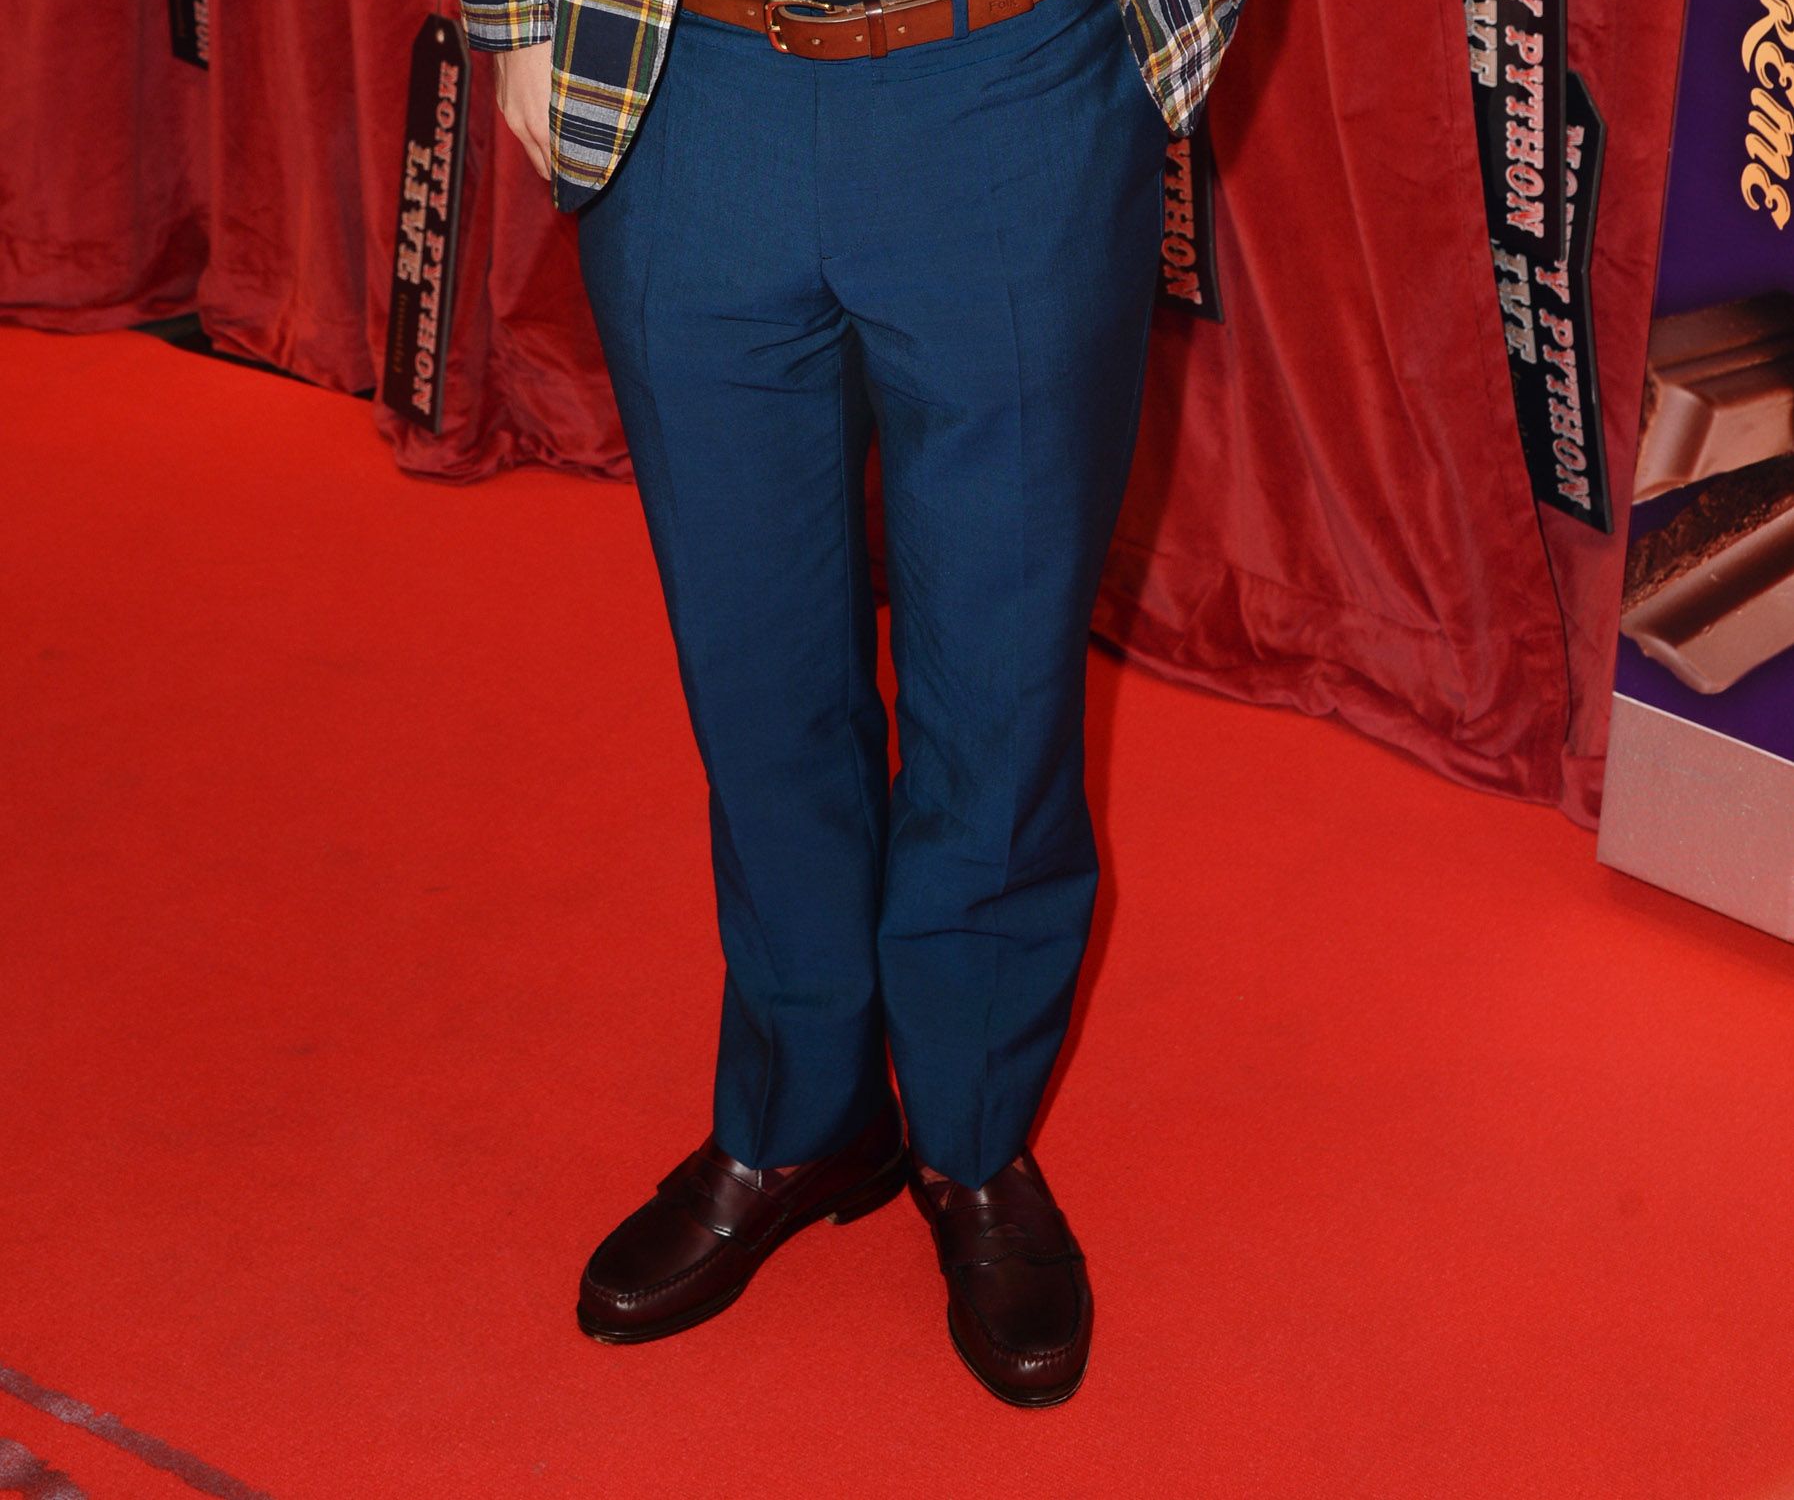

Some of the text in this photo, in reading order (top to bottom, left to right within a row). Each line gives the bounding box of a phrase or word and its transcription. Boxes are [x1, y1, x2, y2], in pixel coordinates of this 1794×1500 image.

[397, 140, 432, 285] LIVE
[1161, 138, 1203, 305] YTHON
[1505, 25, 1545, 238] PYTHON
[412, 61, 460, 416] MONTY PYTHON
[1489, 238, 1537, 364] IVE
[1538, 308, 1592, 511] PYTHON
